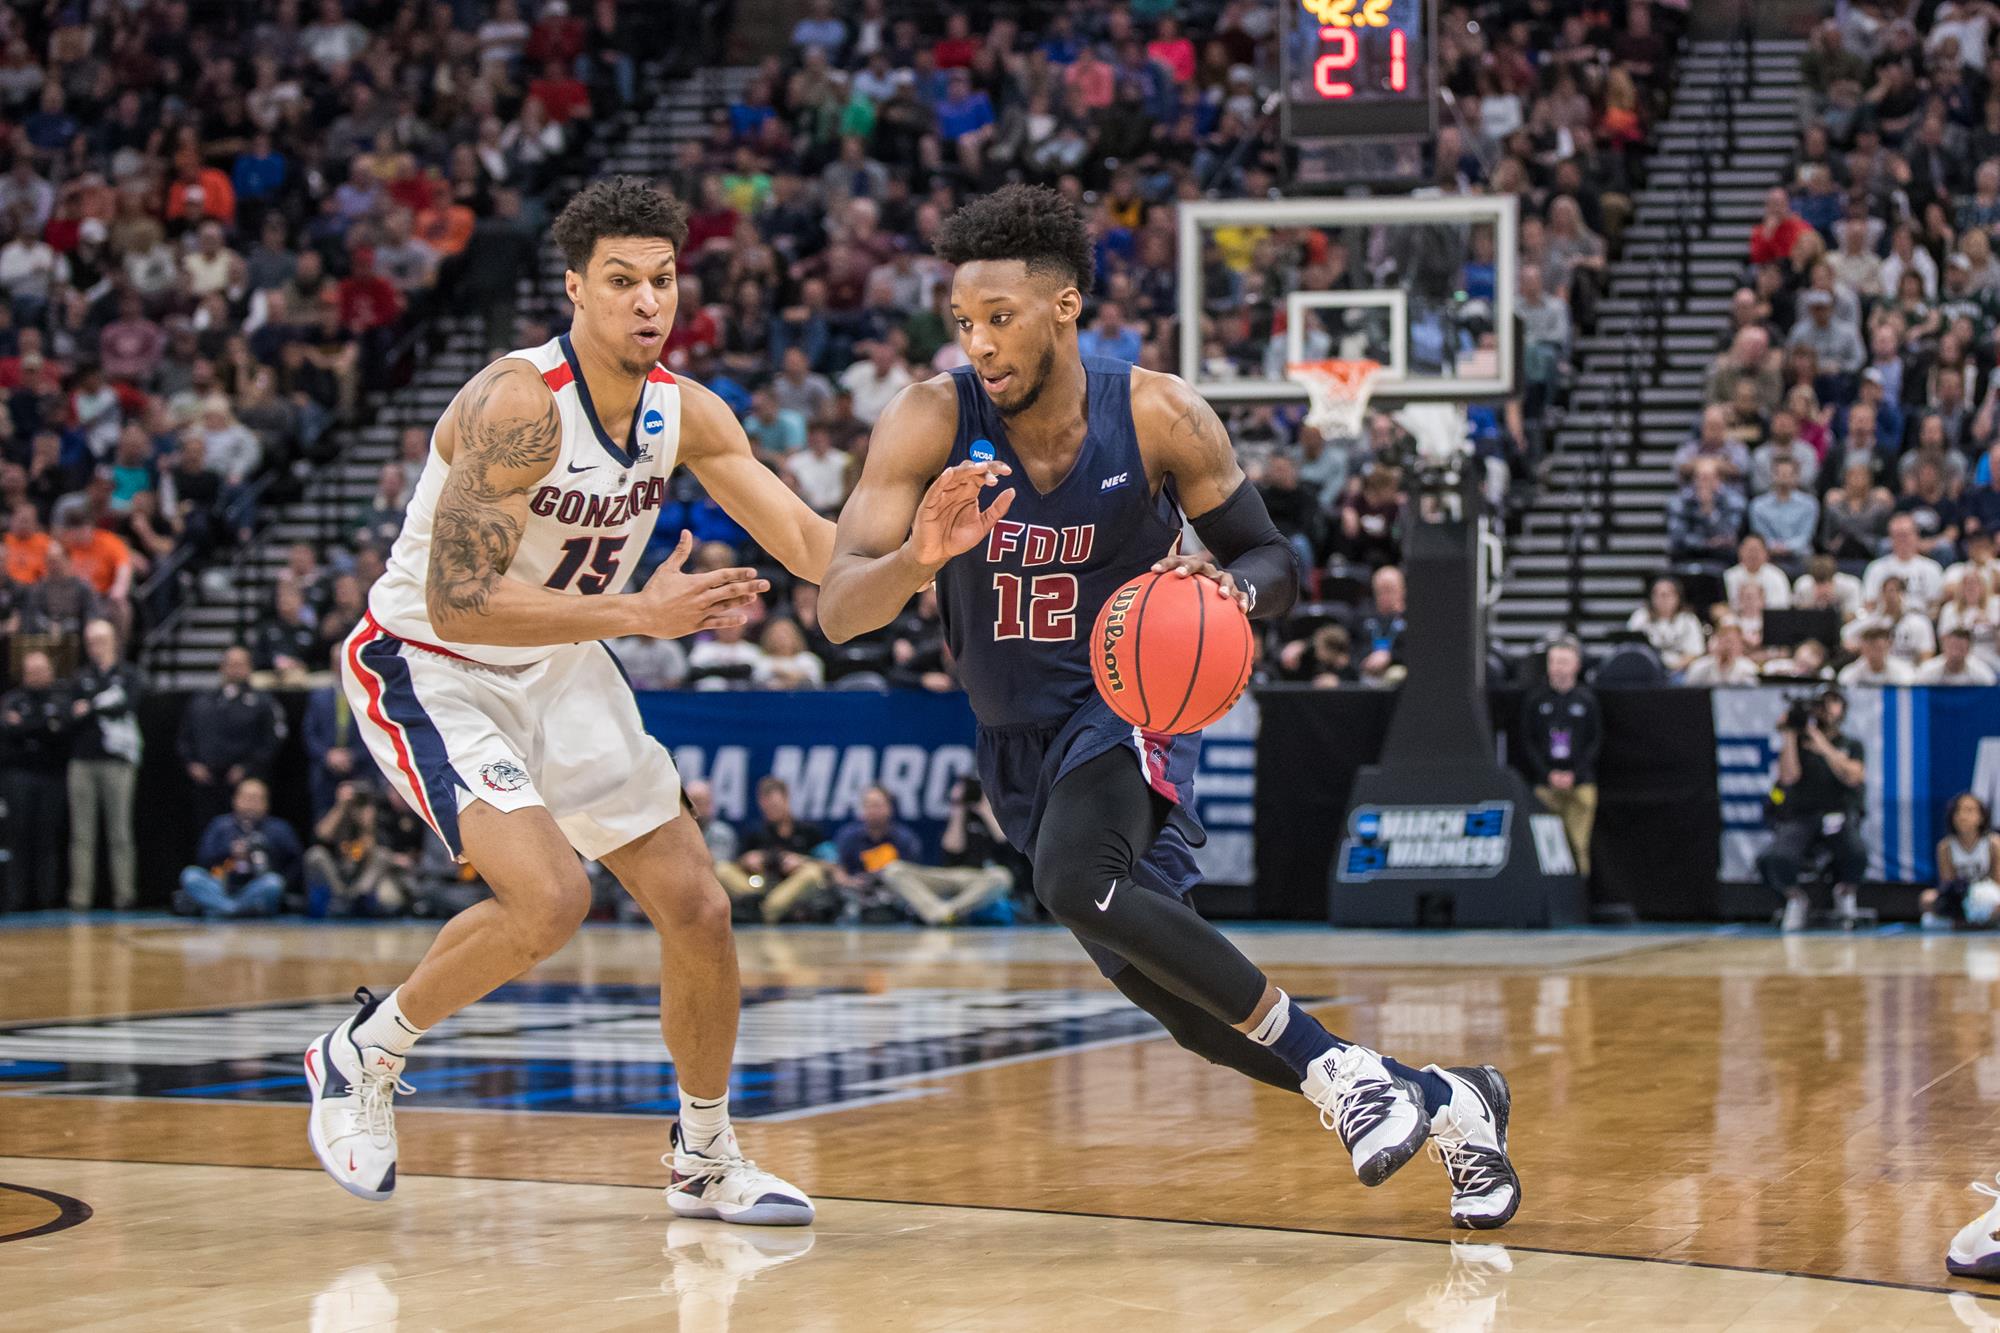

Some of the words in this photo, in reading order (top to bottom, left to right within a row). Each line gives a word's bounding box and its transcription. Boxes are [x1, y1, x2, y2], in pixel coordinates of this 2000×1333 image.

[1314, 26, 1407, 99] 21
[646, 420, 664, 429] NCAA
[972, 449, 994, 462] NCAA
[1100, 472, 1128, 489] NEC
[544, 534, 630, 595] 15
[986, 520, 1095, 567] FDU
[993, 572, 1079, 642] 12
[1102, 584, 1142, 693] Wilson
[770, 744, 977, 821] MARC
